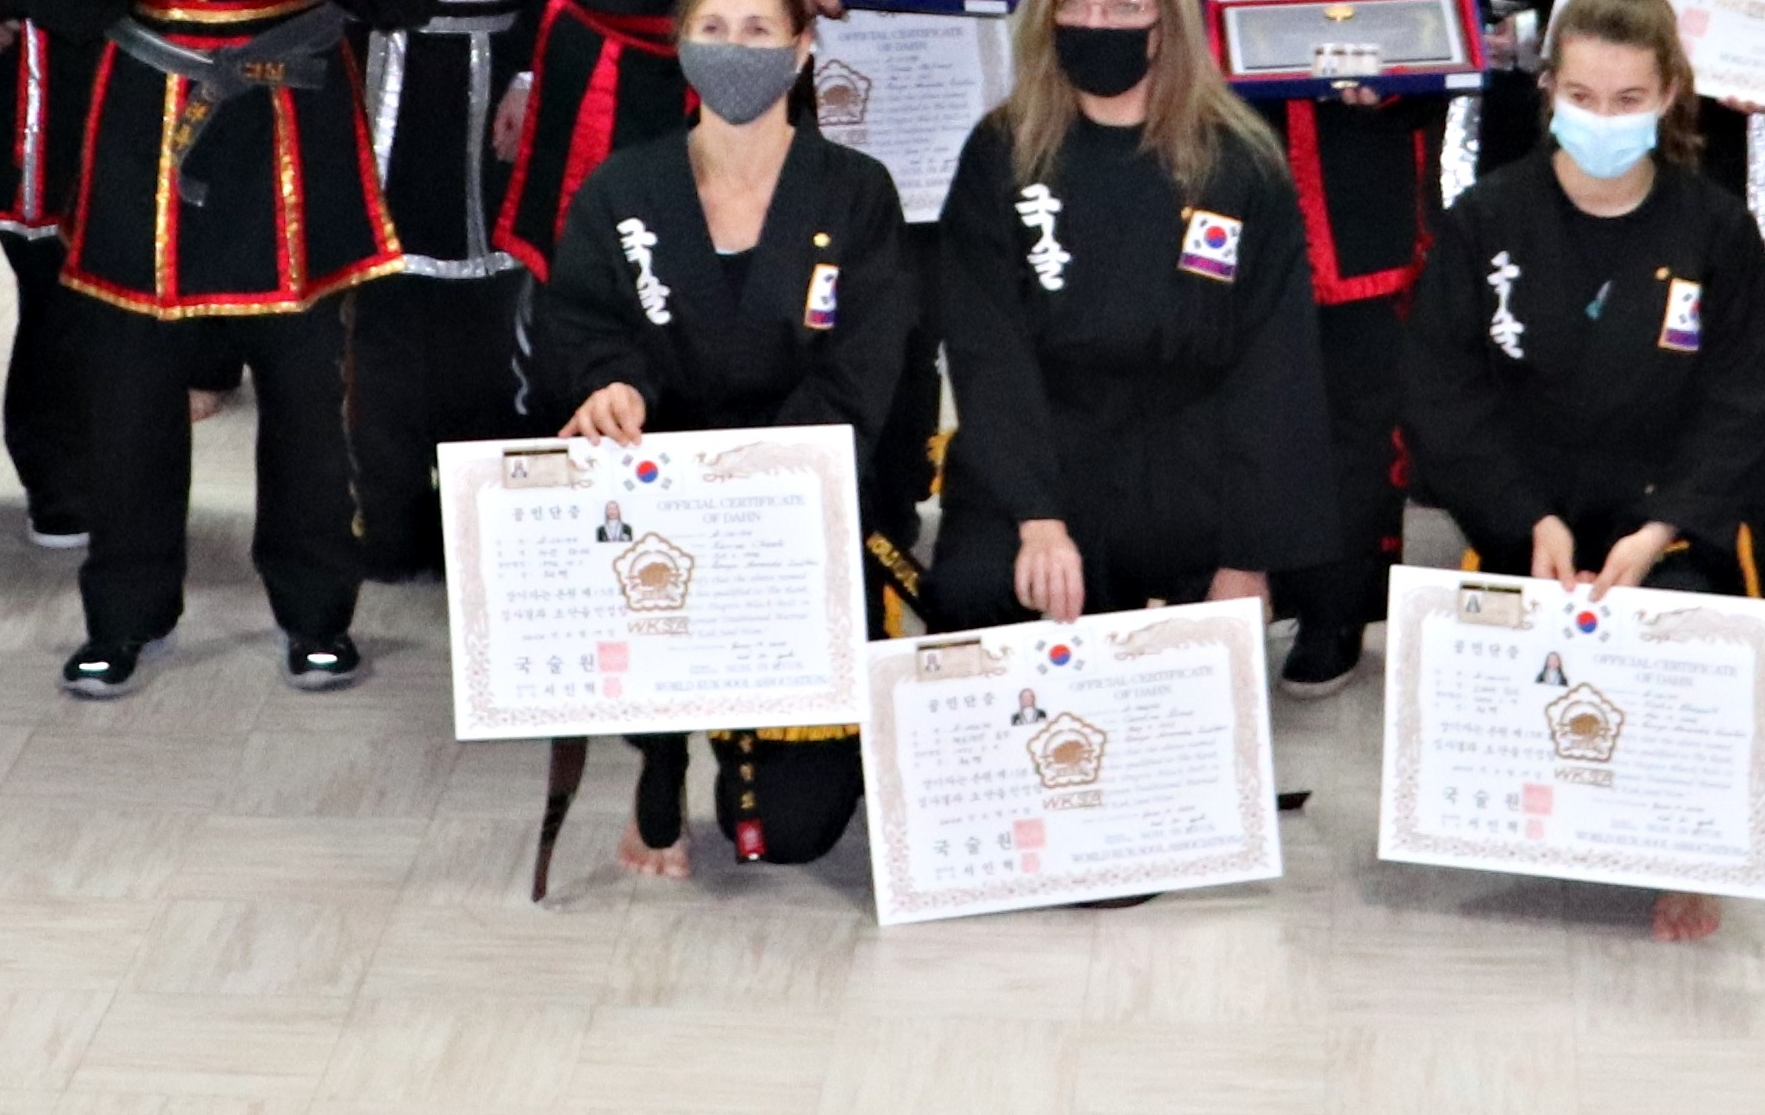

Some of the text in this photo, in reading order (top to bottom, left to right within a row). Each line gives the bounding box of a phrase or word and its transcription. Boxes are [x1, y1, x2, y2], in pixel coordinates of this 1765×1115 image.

[1015, 183, 1071, 290] 국술
[617, 218, 671, 324] 국술
[656, 494, 805, 511] OFFICIAL CERTIFICATE
[702, 510, 761, 523] OF DAHN
[627, 617, 690, 636] WKSA
